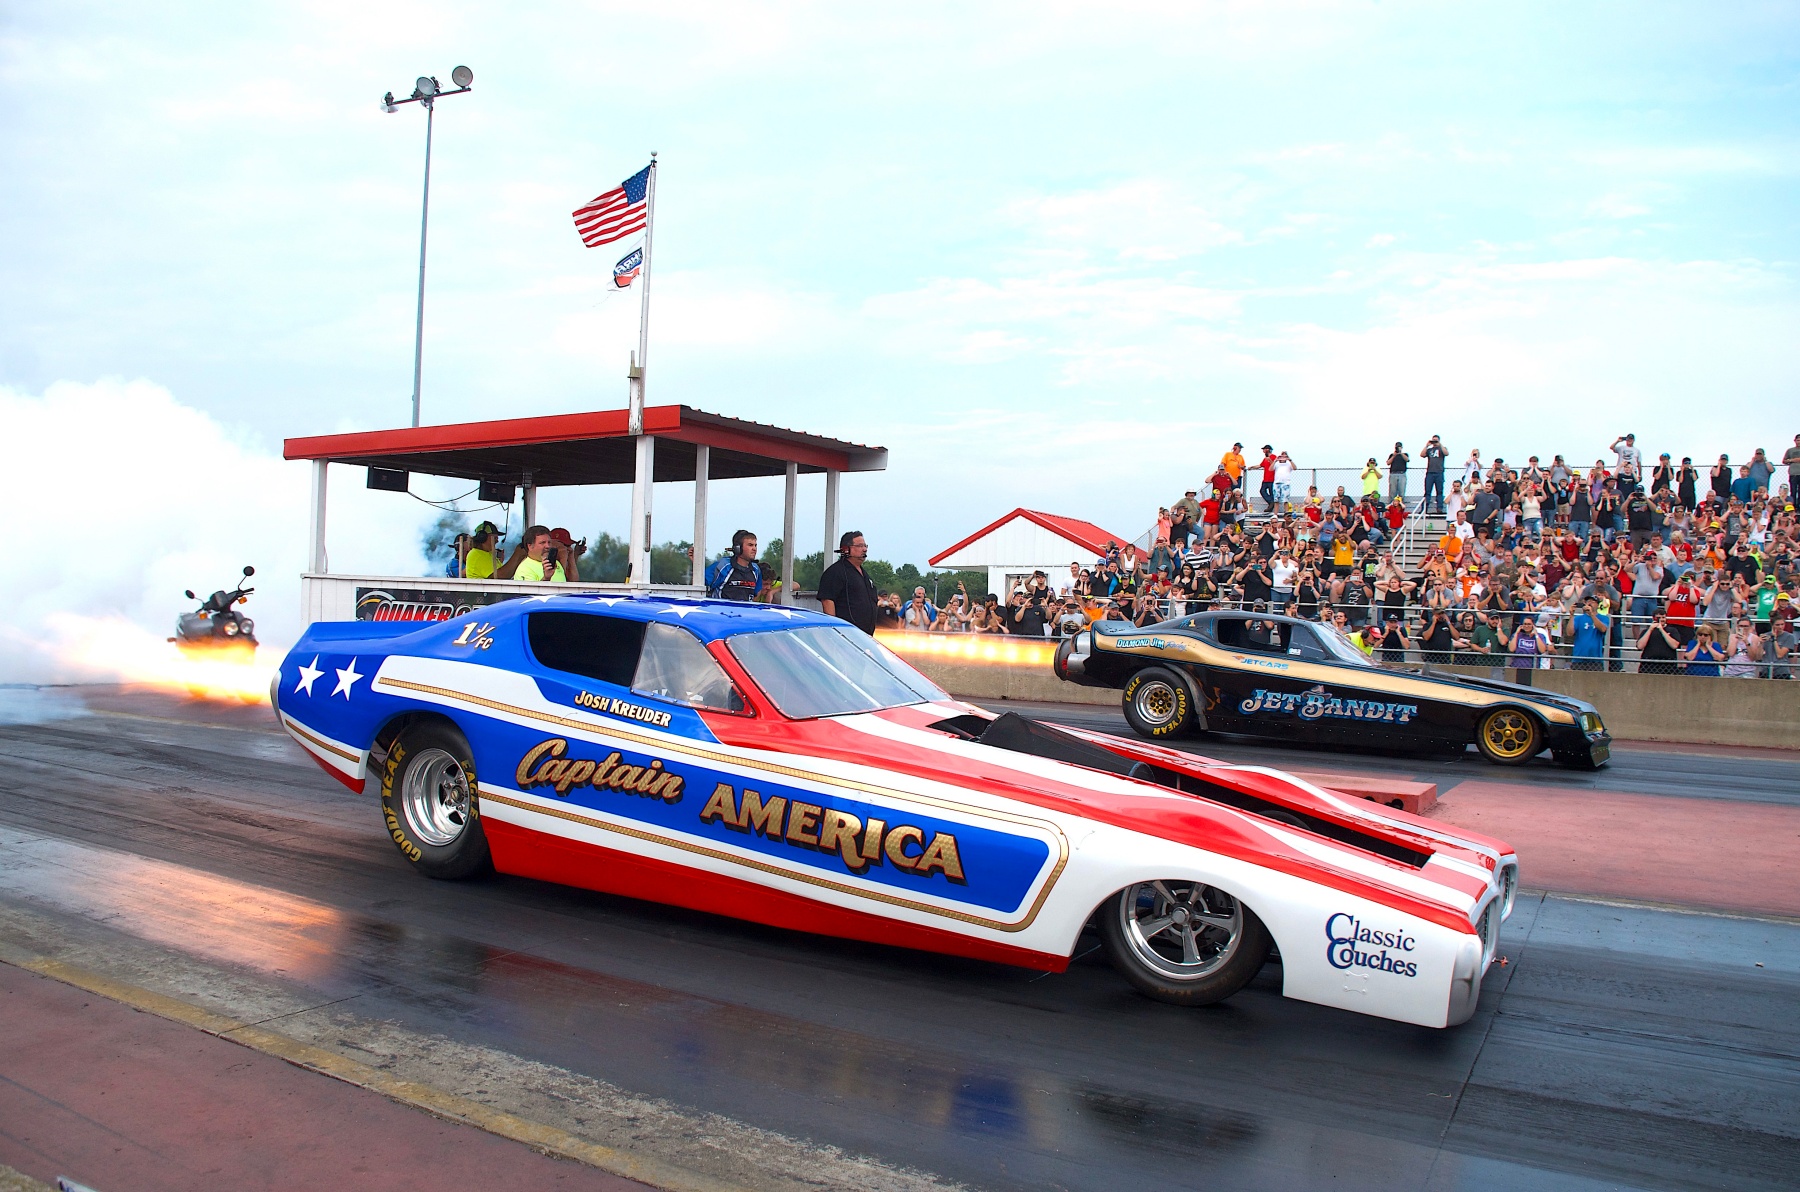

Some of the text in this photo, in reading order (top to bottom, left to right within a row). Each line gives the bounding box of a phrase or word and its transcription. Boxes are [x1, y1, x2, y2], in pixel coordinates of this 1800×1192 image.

[374, 601, 454, 621] QUAKER
[452, 622, 479, 646] 1
[1116, 638, 1150, 649] DIAMOND
[1150, 637, 1165, 651] JIM
[1241, 658, 1289, 670] JETCARS
[1125, 676, 1141, 702] EAGLE
[1239, 688, 1418, 724] JET BANDIT
[574, 690, 672, 728] JOSH KREUDER
[1153, 687, 1187, 735] GOODYEAR
[461, 759, 479, 820] EAGLE
[516, 738, 684, 804] Captain
[381, 742, 422, 862] GOODYEAR
[700, 782, 968, 886] AMERICA
[1325, 912, 1416, 951] Classic
[1326, 937, 1417, 978] Couches
